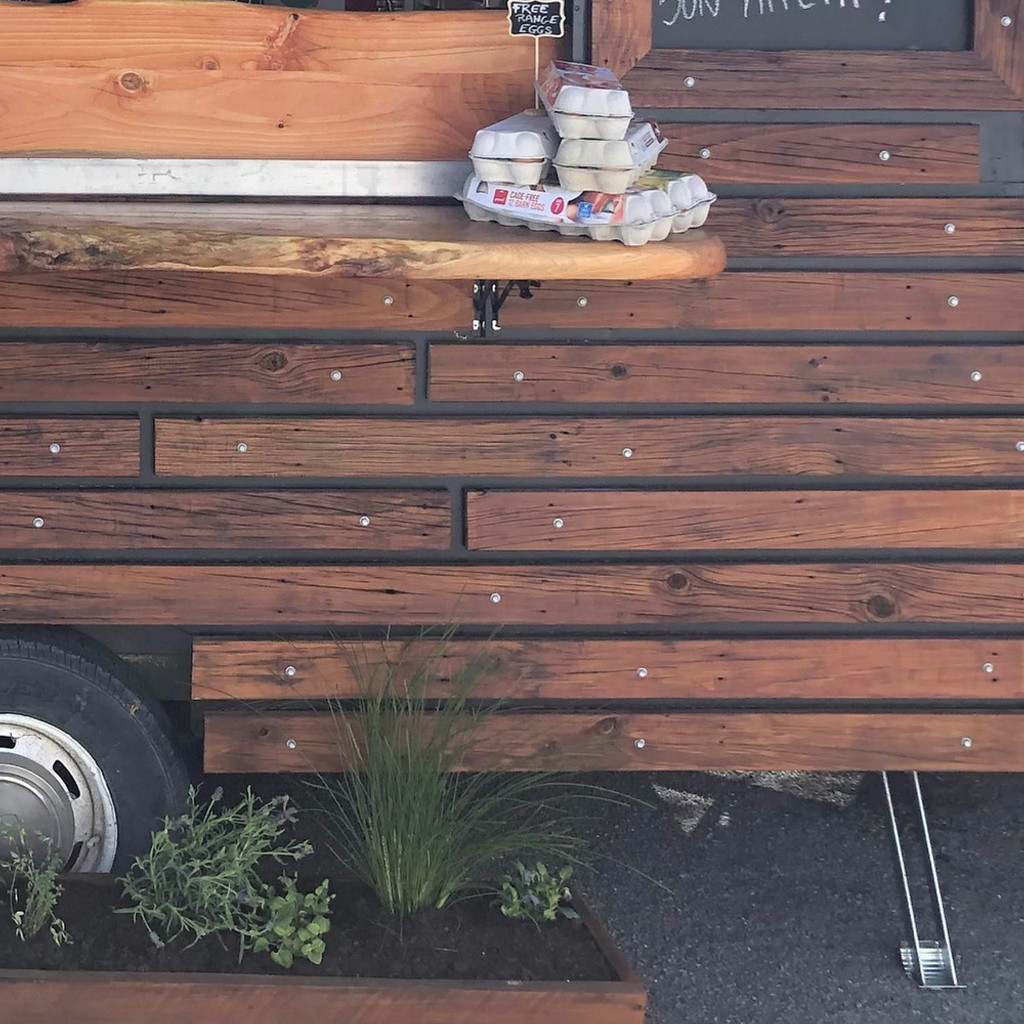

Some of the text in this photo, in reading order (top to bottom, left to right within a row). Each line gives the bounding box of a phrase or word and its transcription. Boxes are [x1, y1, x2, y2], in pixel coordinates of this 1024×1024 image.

[512, 3, 550, 15] FREE
[514, 13, 560, 25] RANGE
[518, 23, 554, 36] EGGS
[554, 202, 560, 214] 7
